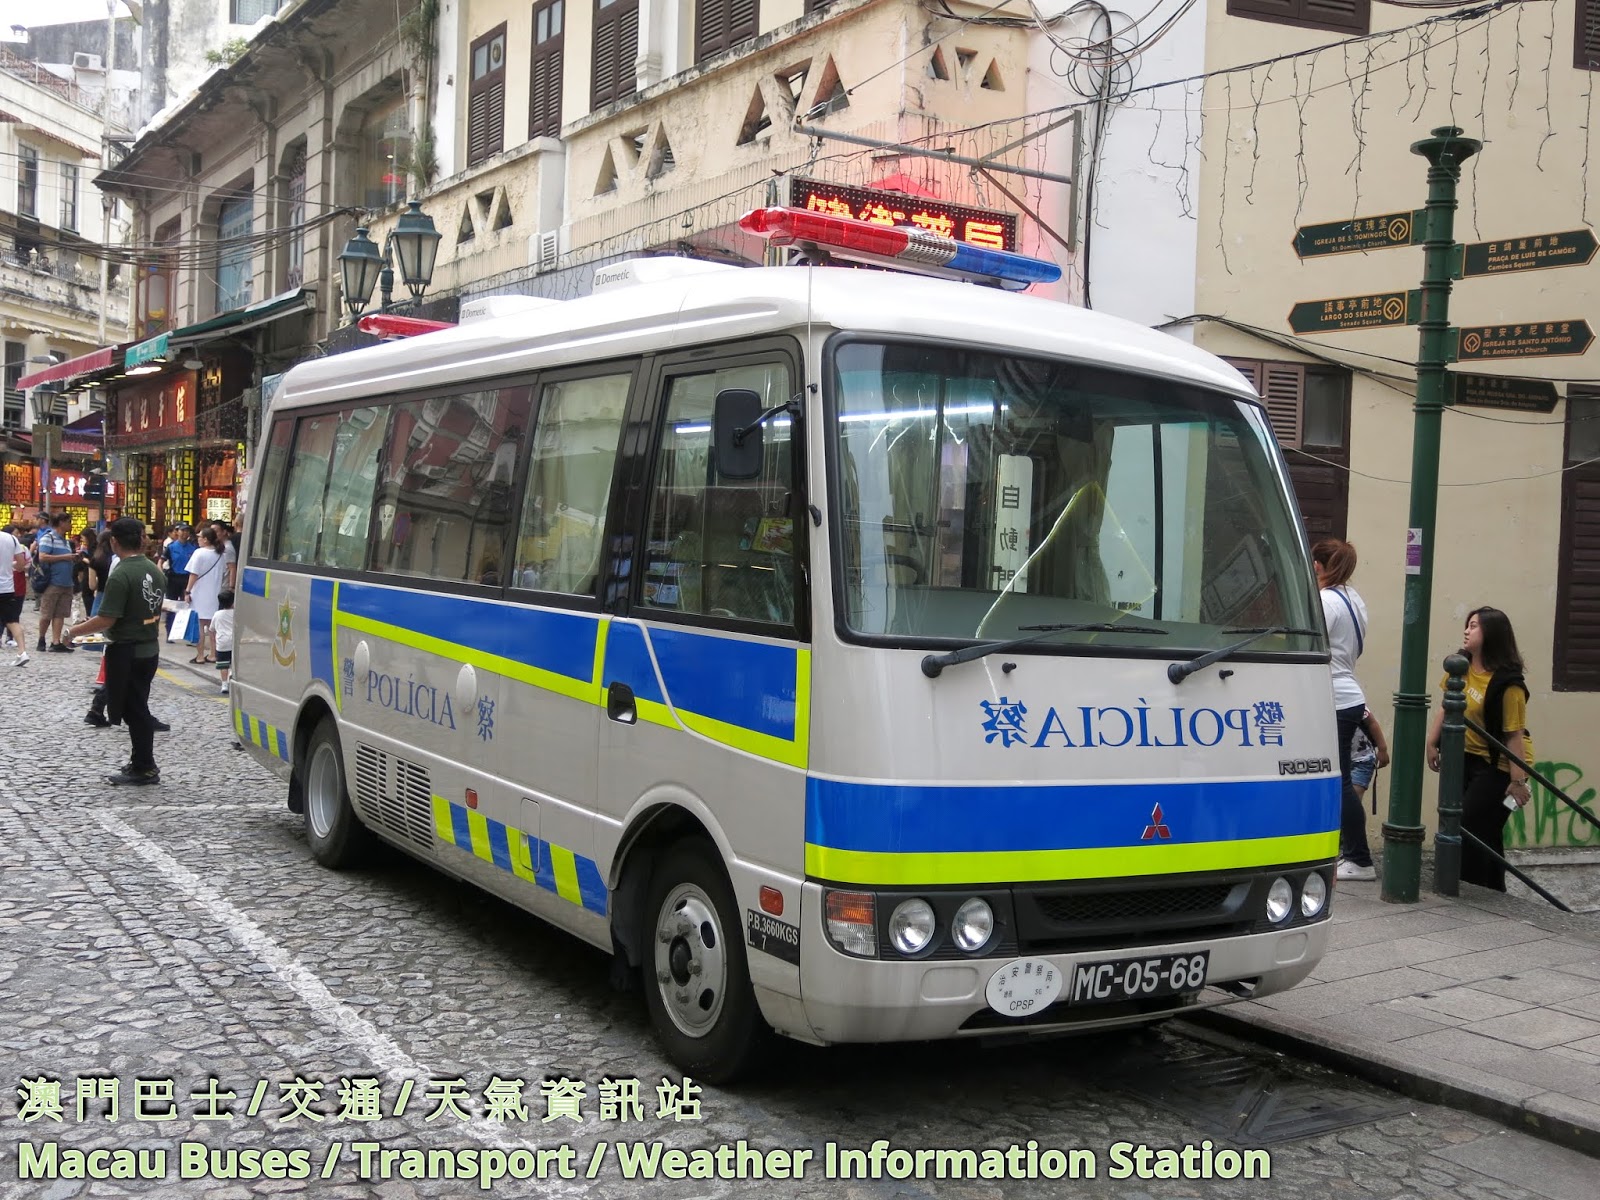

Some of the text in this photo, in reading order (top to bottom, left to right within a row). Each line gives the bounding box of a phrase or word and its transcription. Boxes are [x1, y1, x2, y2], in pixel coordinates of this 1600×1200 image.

[1353, 218, 1387, 233] 玫瑰堂
[1314, 237, 1337, 246] IGREJA
[1337, 235, 1346, 243] DE
[1354, 230, 1387, 241] DOMINGOS
[1367, 240, 1387, 248] Church
[1513, 260, 1536, 269] Square
[601, 269, 630, 285] Dometic
[465, 308, 487, 319] Dometic
[1320, 313, 1341, 322] LARGO
[1355, 309, 1382, 318] SENADO
[1362, 318, 1382, 326] Square
[1482, 340, 1505, 348] IGREJA
[1492, 348, 1523, 356] Anthony's
[1524, 346, 1548, 354] Church
[367, 669, 457, 730] POLÍCIA
[477, 695, 495, 742] 察
[1278, 757, 1332, 775] ROSA
[762, 934, 767, 950] 7
[1074, 954, 1206, 1001] MC-05-68
[1009, 999, 1034, 1011] CPSP
